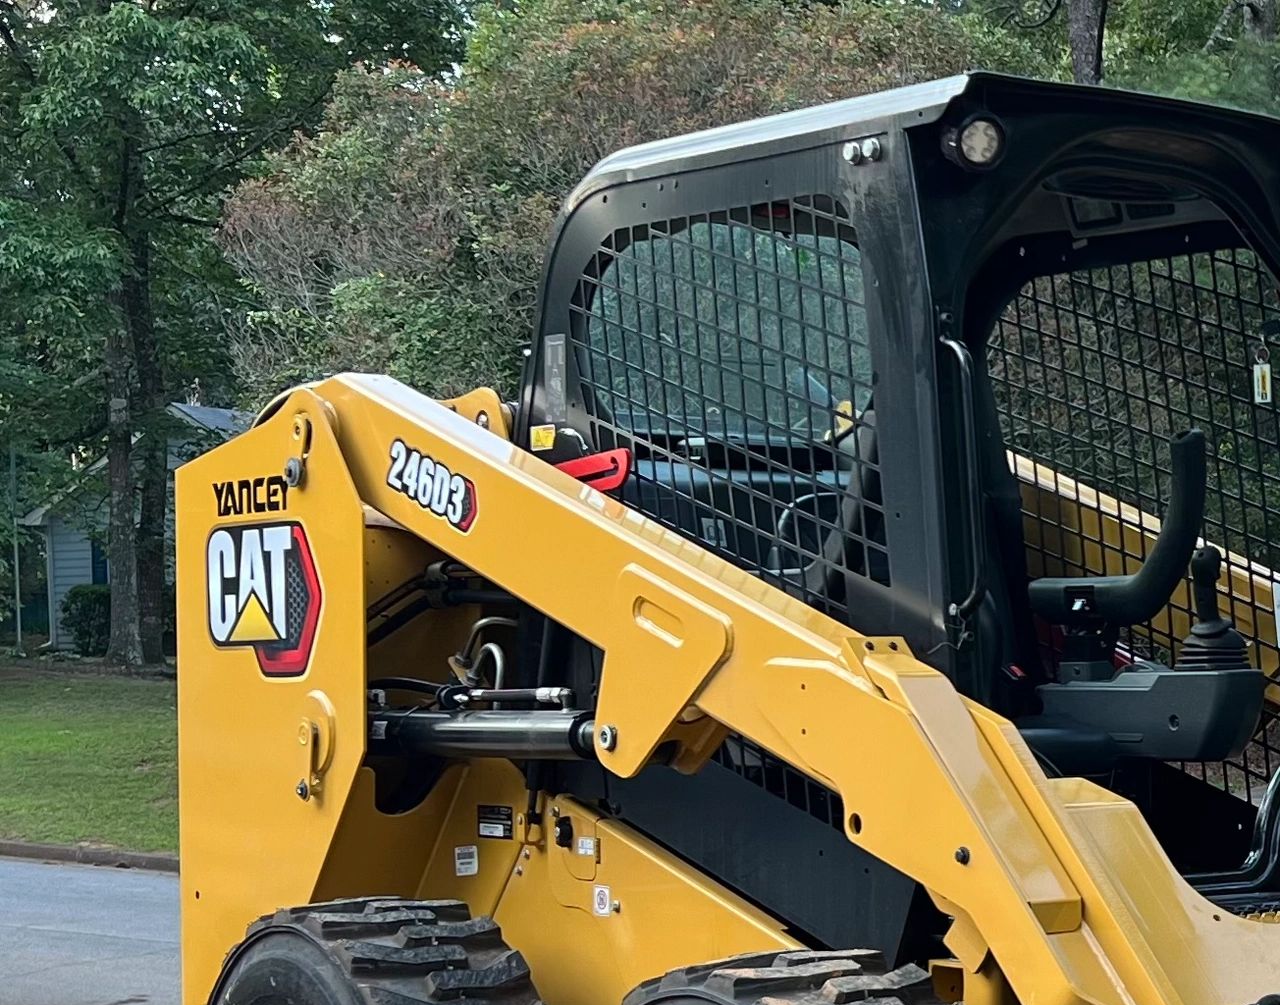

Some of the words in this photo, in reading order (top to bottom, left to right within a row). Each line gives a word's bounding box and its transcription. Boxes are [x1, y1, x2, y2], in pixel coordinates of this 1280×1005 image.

[212, 475, 289, 517] YANCEY
[387, 440, 466, 524] 246D3
[208, 526, 292, 642] CAT
